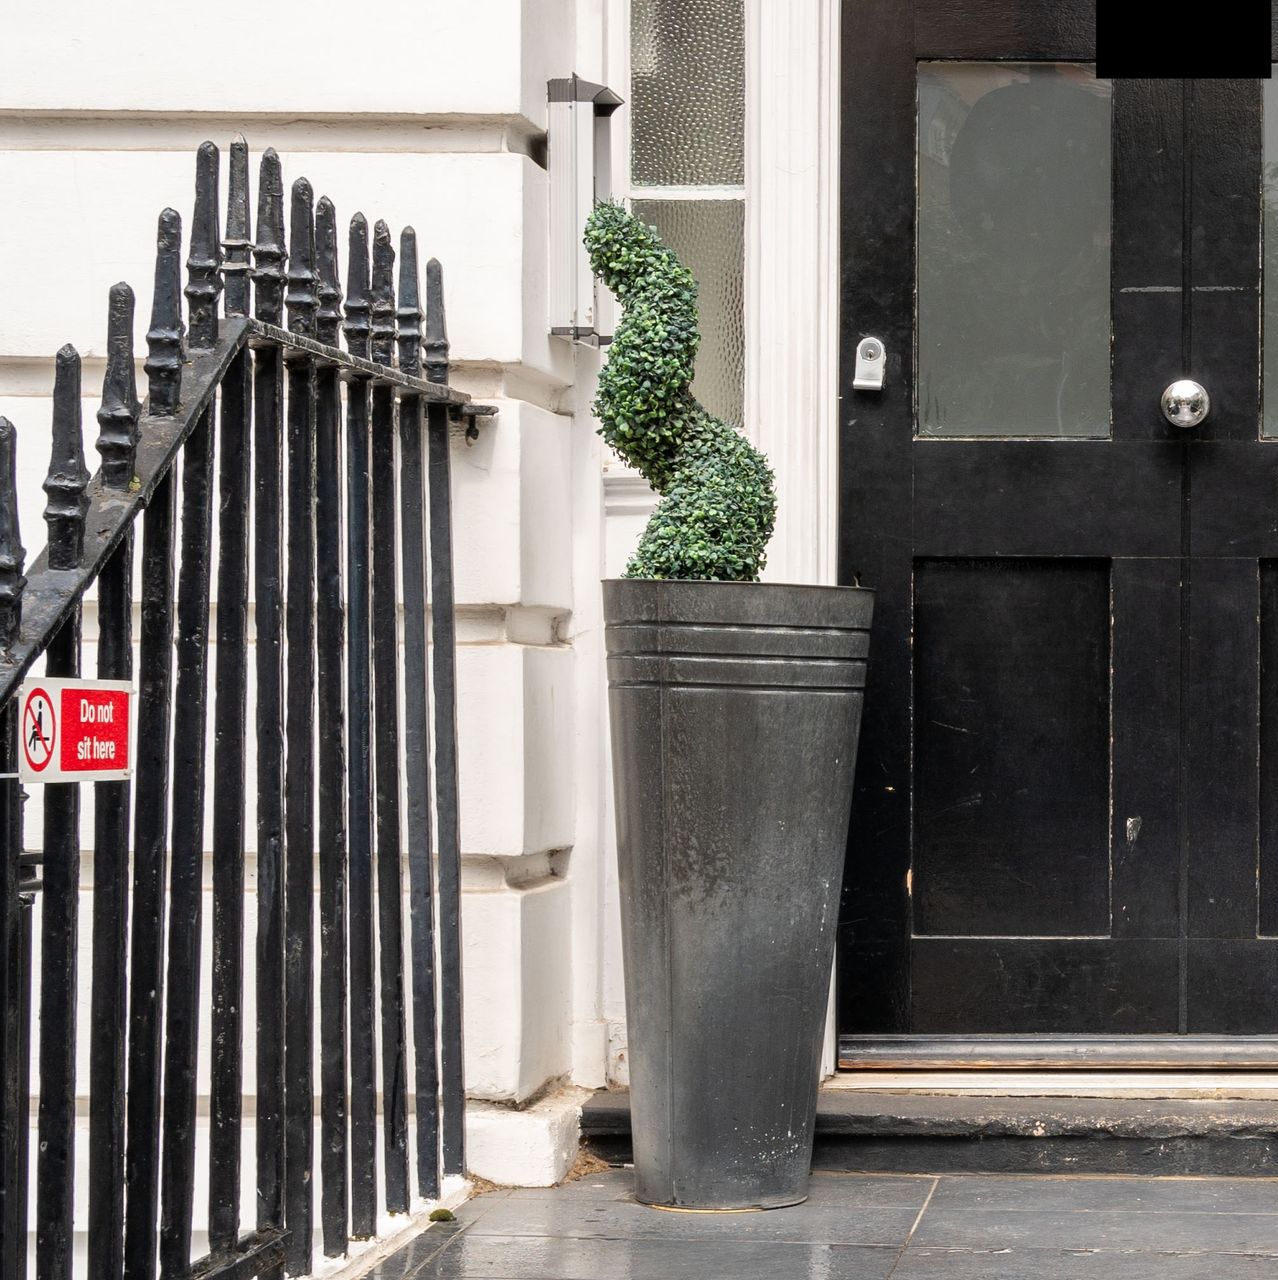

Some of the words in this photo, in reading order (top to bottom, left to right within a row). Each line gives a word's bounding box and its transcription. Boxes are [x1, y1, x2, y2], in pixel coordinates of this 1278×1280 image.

[80, 699, 95, 723] Do
[97, 701, 114, 723] not
[77, 736, 91, 759] sit
[93, 736, 116, 759] here
